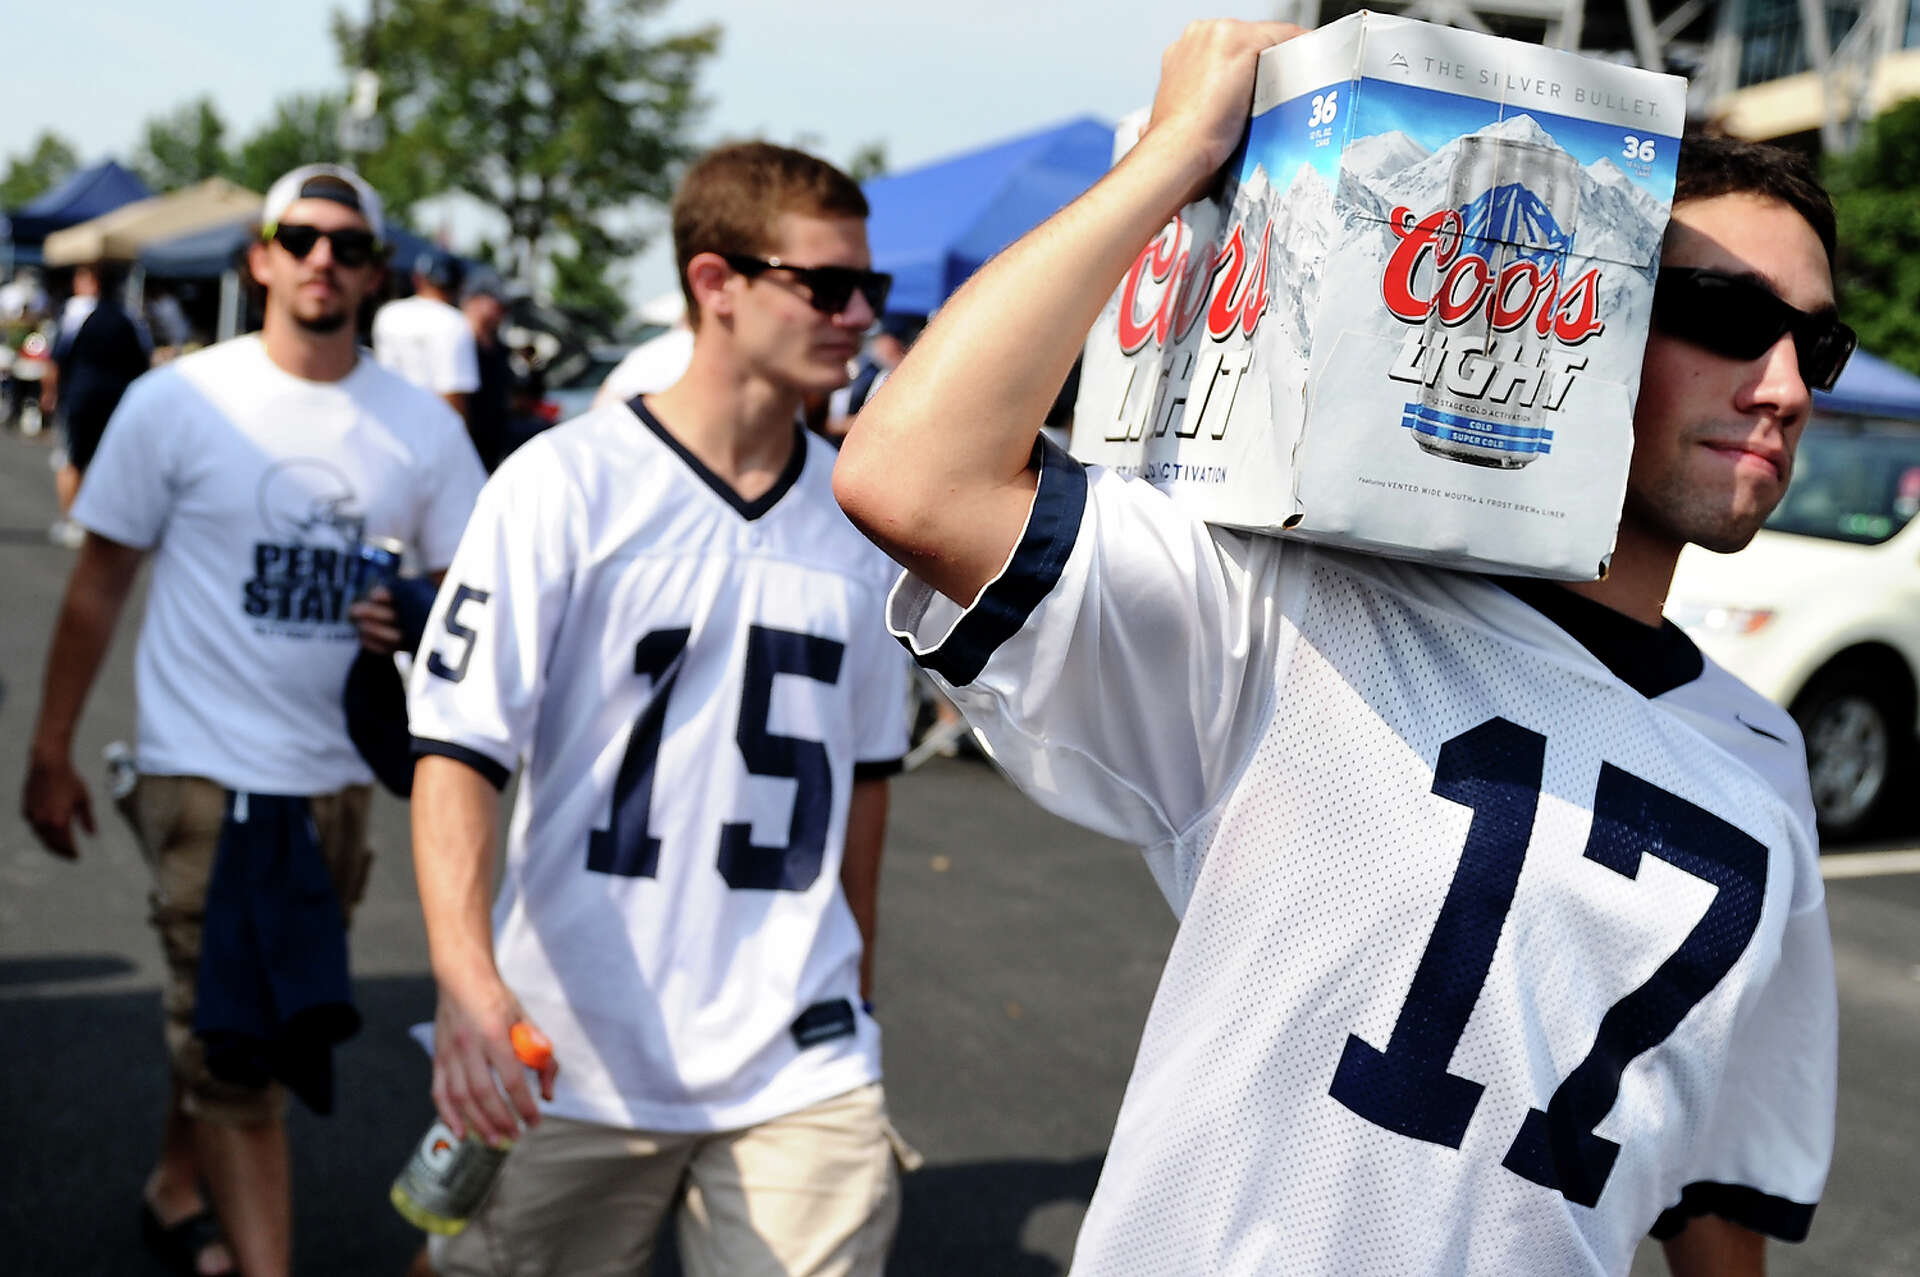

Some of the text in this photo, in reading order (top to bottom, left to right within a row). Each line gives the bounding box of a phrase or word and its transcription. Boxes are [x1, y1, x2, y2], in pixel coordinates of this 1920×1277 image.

[1308, 90, 1338, 128] 36
[1424, 56, 1657, 117] THE SILVER BULLET
[1622, 135, 1656, 162] 36
[1381, 206, 1605, 347] Coors
[1104, 350, 1254, 441] LIHT
[1388, 327, 1588, 411] LIGHT
[1440, 400, 1463, 411] STAGE
[1465, 405, 1487, 415] COLD
[1489, 409, 1532, 422] ACTIVATION
[1452, 432, 1505, 448] SUPER COLD
[1469, 421, 1493, 432] COLD
[1388, 481, 1419, 493] VENTED
[1421, 488, 1441, 497] WIDE
[1486, 498, 1512, 509] FROST
[427, 584, 488, 683] 5
[586, 624, 845, 892] 15
[1328, 716, 1769, 1208] 17
